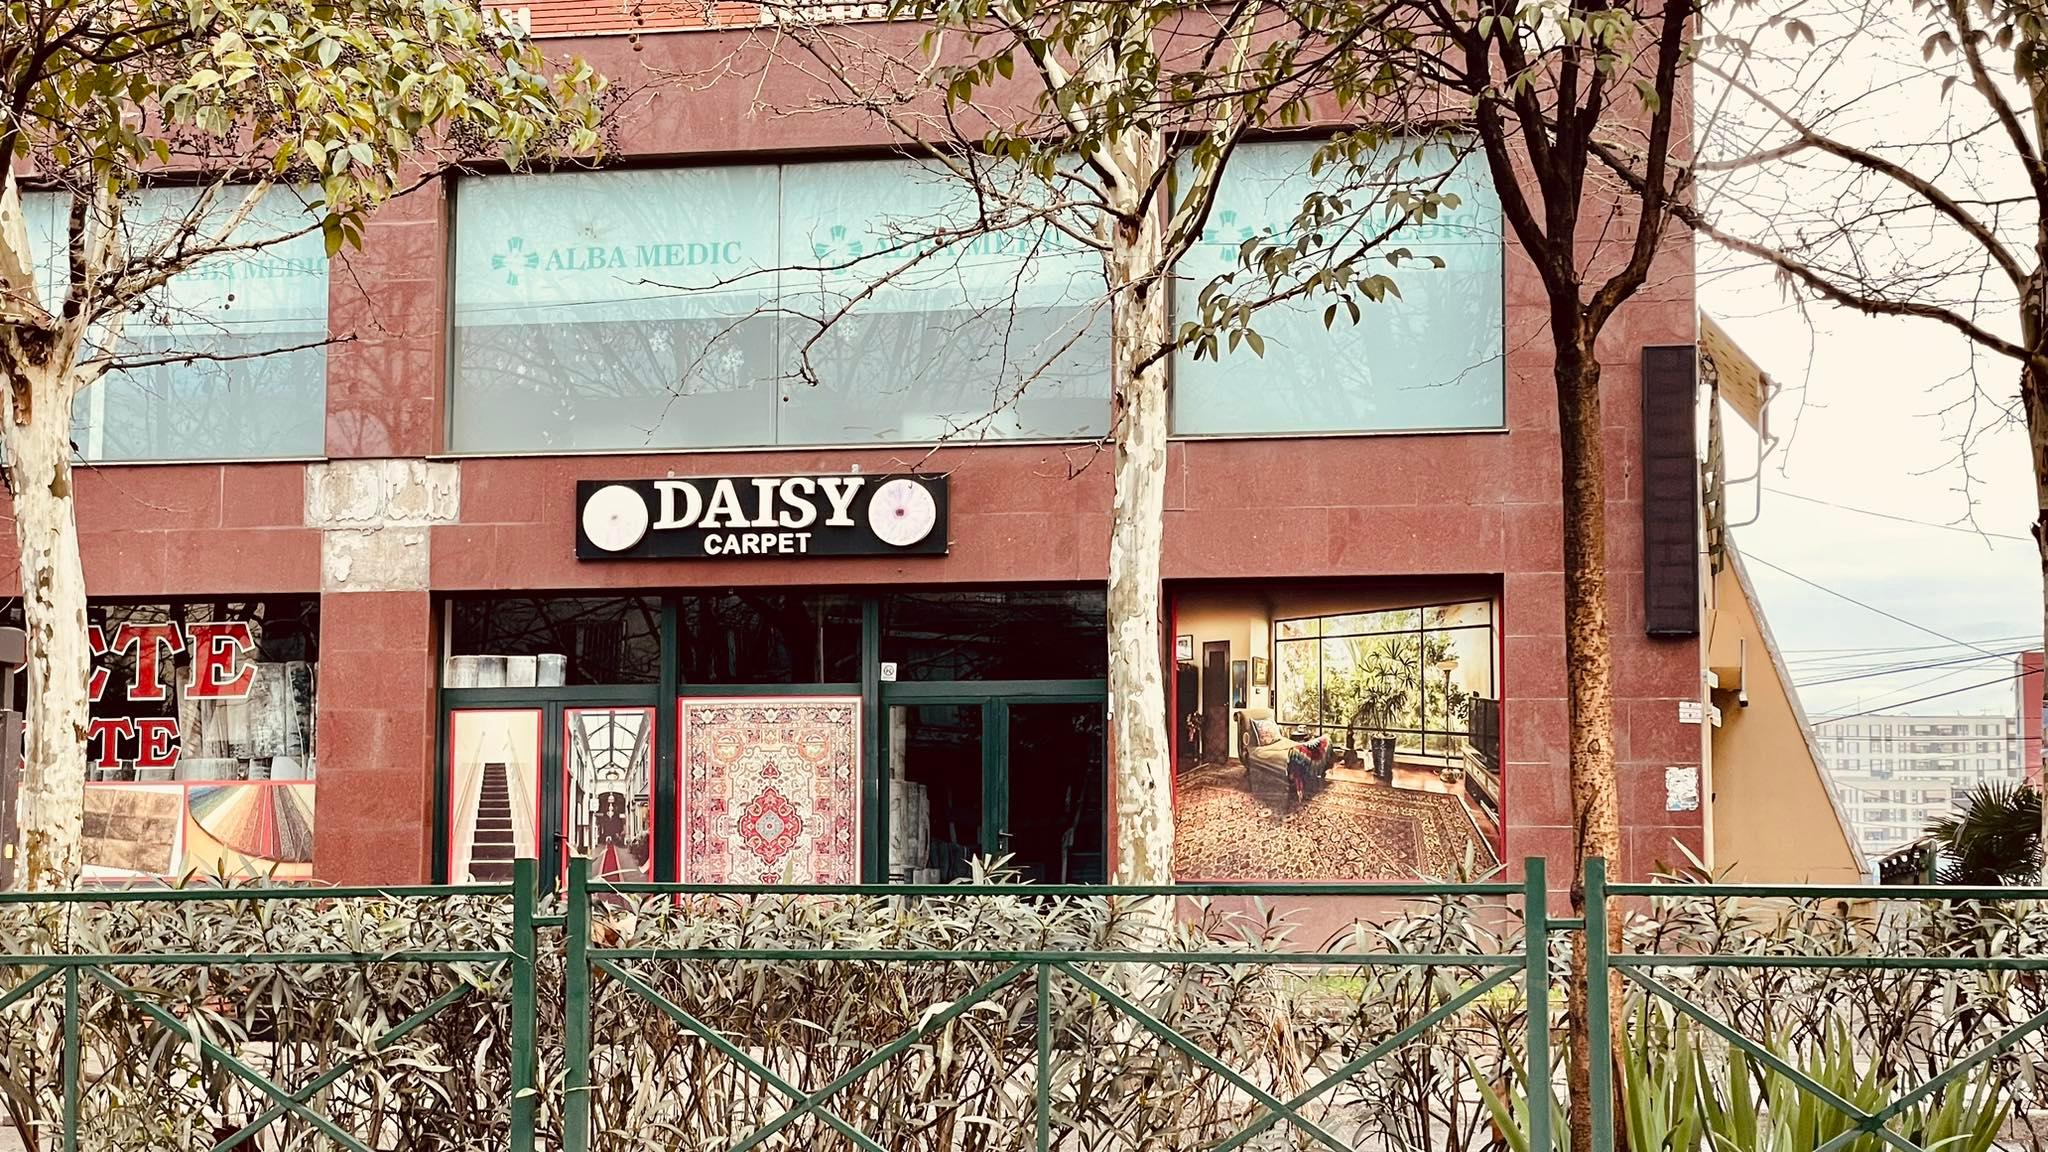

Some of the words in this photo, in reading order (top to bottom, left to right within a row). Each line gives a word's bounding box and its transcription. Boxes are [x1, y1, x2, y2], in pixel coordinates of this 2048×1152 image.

[545, 247, 627, 271] ALBA
[636, 241, 743, 267] MEDIC
[653, 478, 865, 530] DAISY
[704, 532, 812, 555] CARPET
